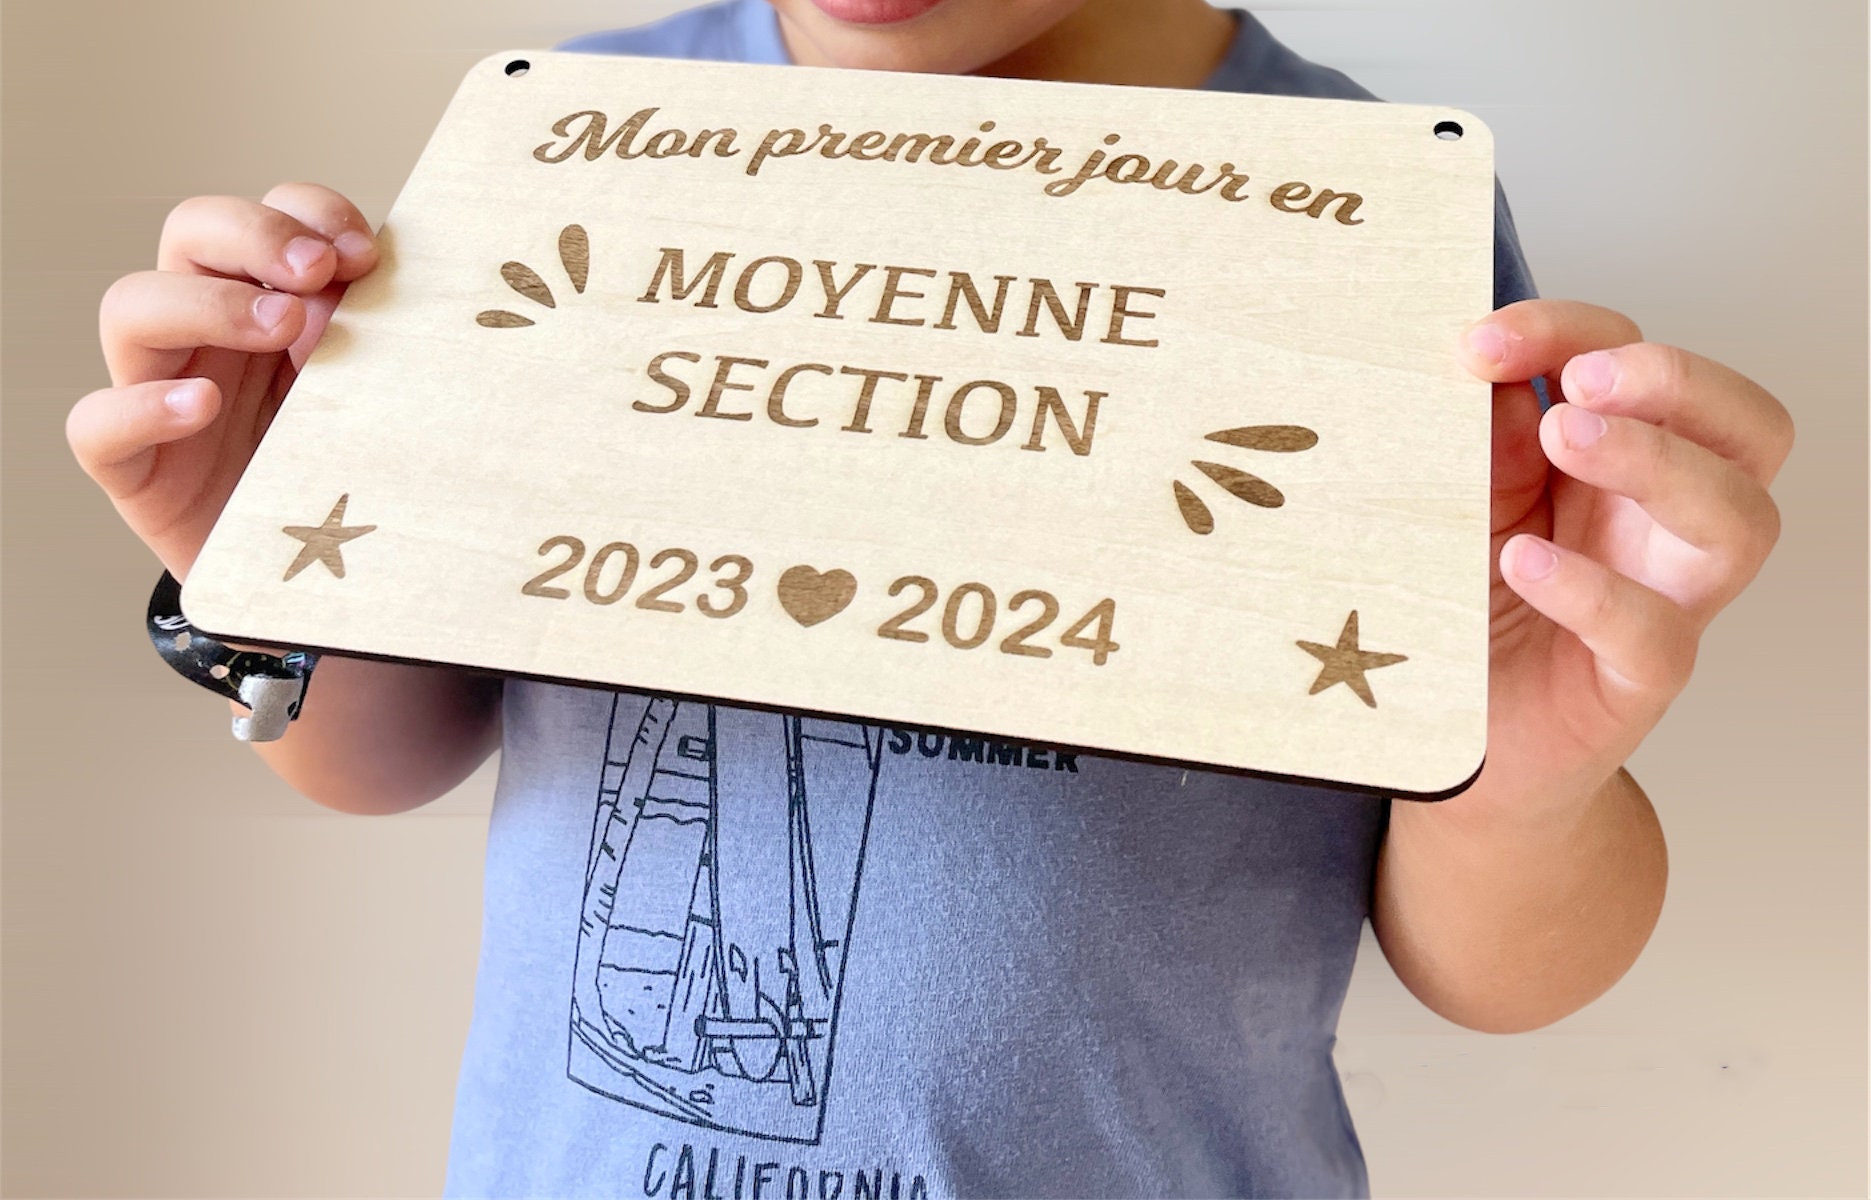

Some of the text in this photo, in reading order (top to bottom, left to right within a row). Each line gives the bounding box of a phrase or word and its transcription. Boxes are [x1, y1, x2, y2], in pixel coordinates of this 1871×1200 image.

[533, 107, 1364, 226] Mon premier jour en
[636, 248, 1166, 348] MOYENNE
[632, 352, 1109, 457] SECTION
[522, 535, 1120, 666] 2023 2024
